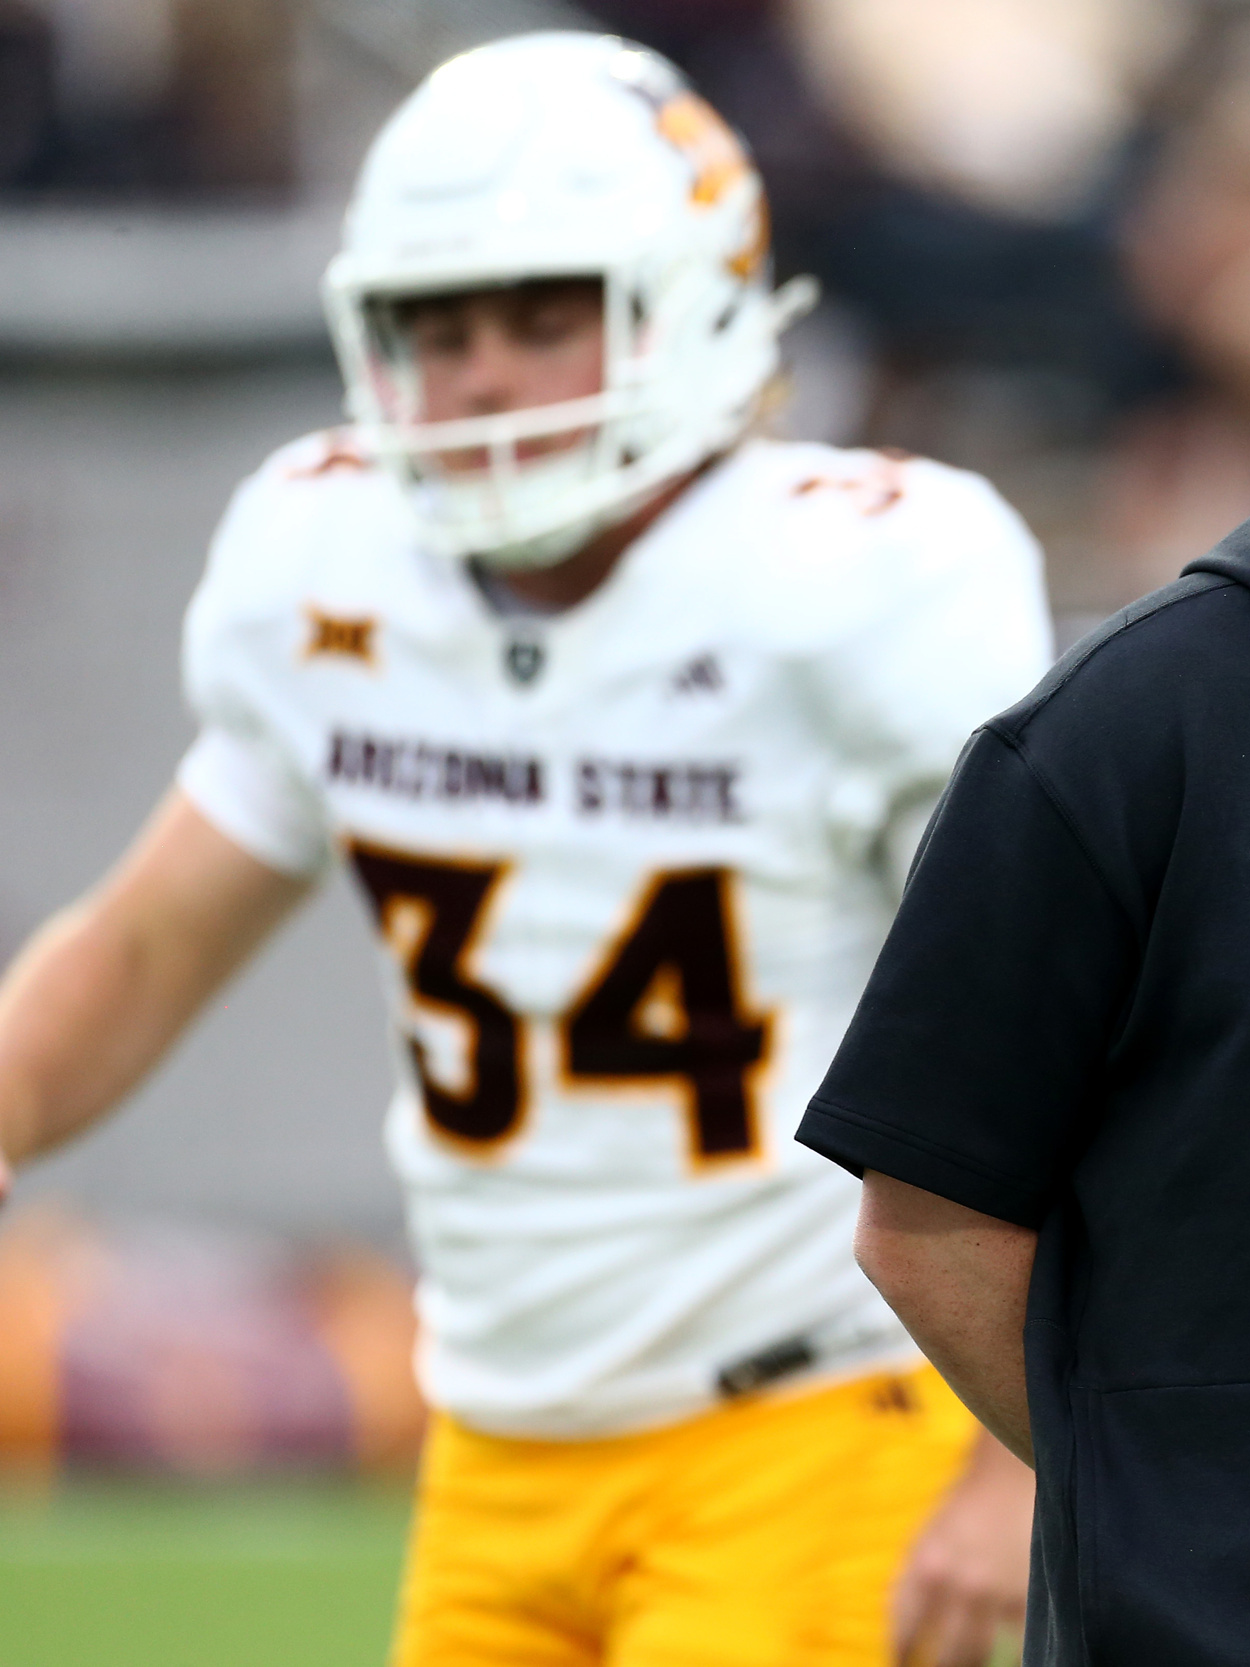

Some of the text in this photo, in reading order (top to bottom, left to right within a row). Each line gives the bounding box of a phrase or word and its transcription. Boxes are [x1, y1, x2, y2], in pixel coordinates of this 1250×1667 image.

[324, 728, 746, 824] ARIZONA STATE
[343, 832, 775, 1176] 34
